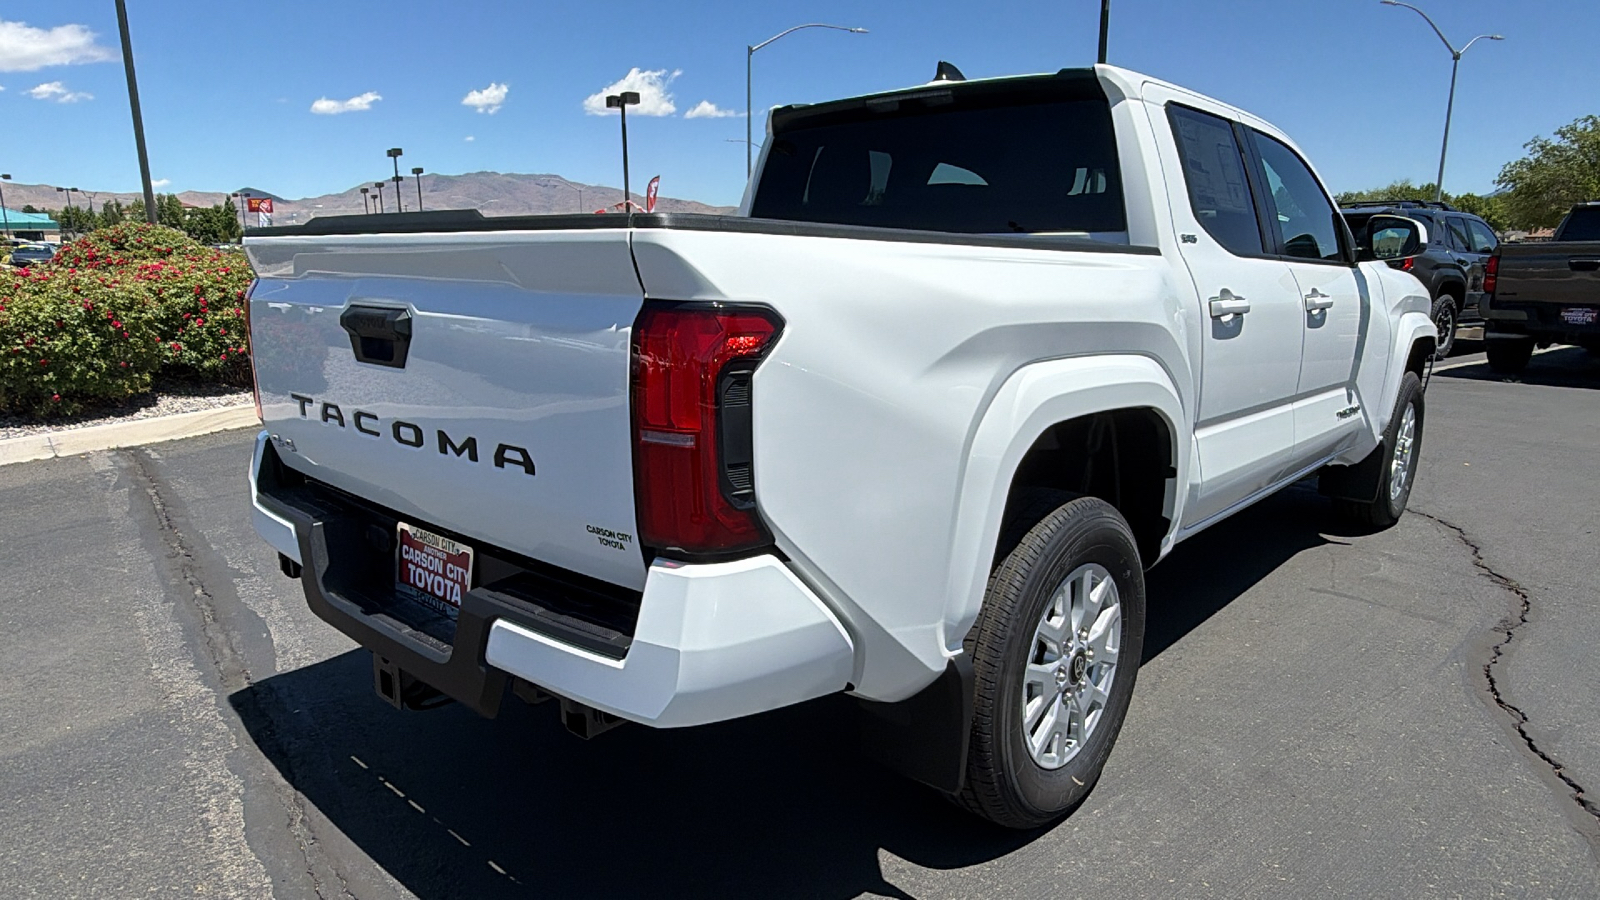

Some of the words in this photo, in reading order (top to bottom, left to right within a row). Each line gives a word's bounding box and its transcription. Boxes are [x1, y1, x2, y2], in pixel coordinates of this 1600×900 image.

[291, 393, 536, 476] TACOMA
[414, 529, 441, 547] CARSON
[441, 538, 456, 553] CITY
[586, 524, 616, 539] CARSON
[616, 532, 633, 543] CITY
[597, 536, 626, 551] TOYOTA
[423, 545, 447, 560] ANOTHER
[402, 544, 443, 574] CARSON
[446, 562, 470, 586] CITY
[407, 563, 462, 606] TOYOTA
